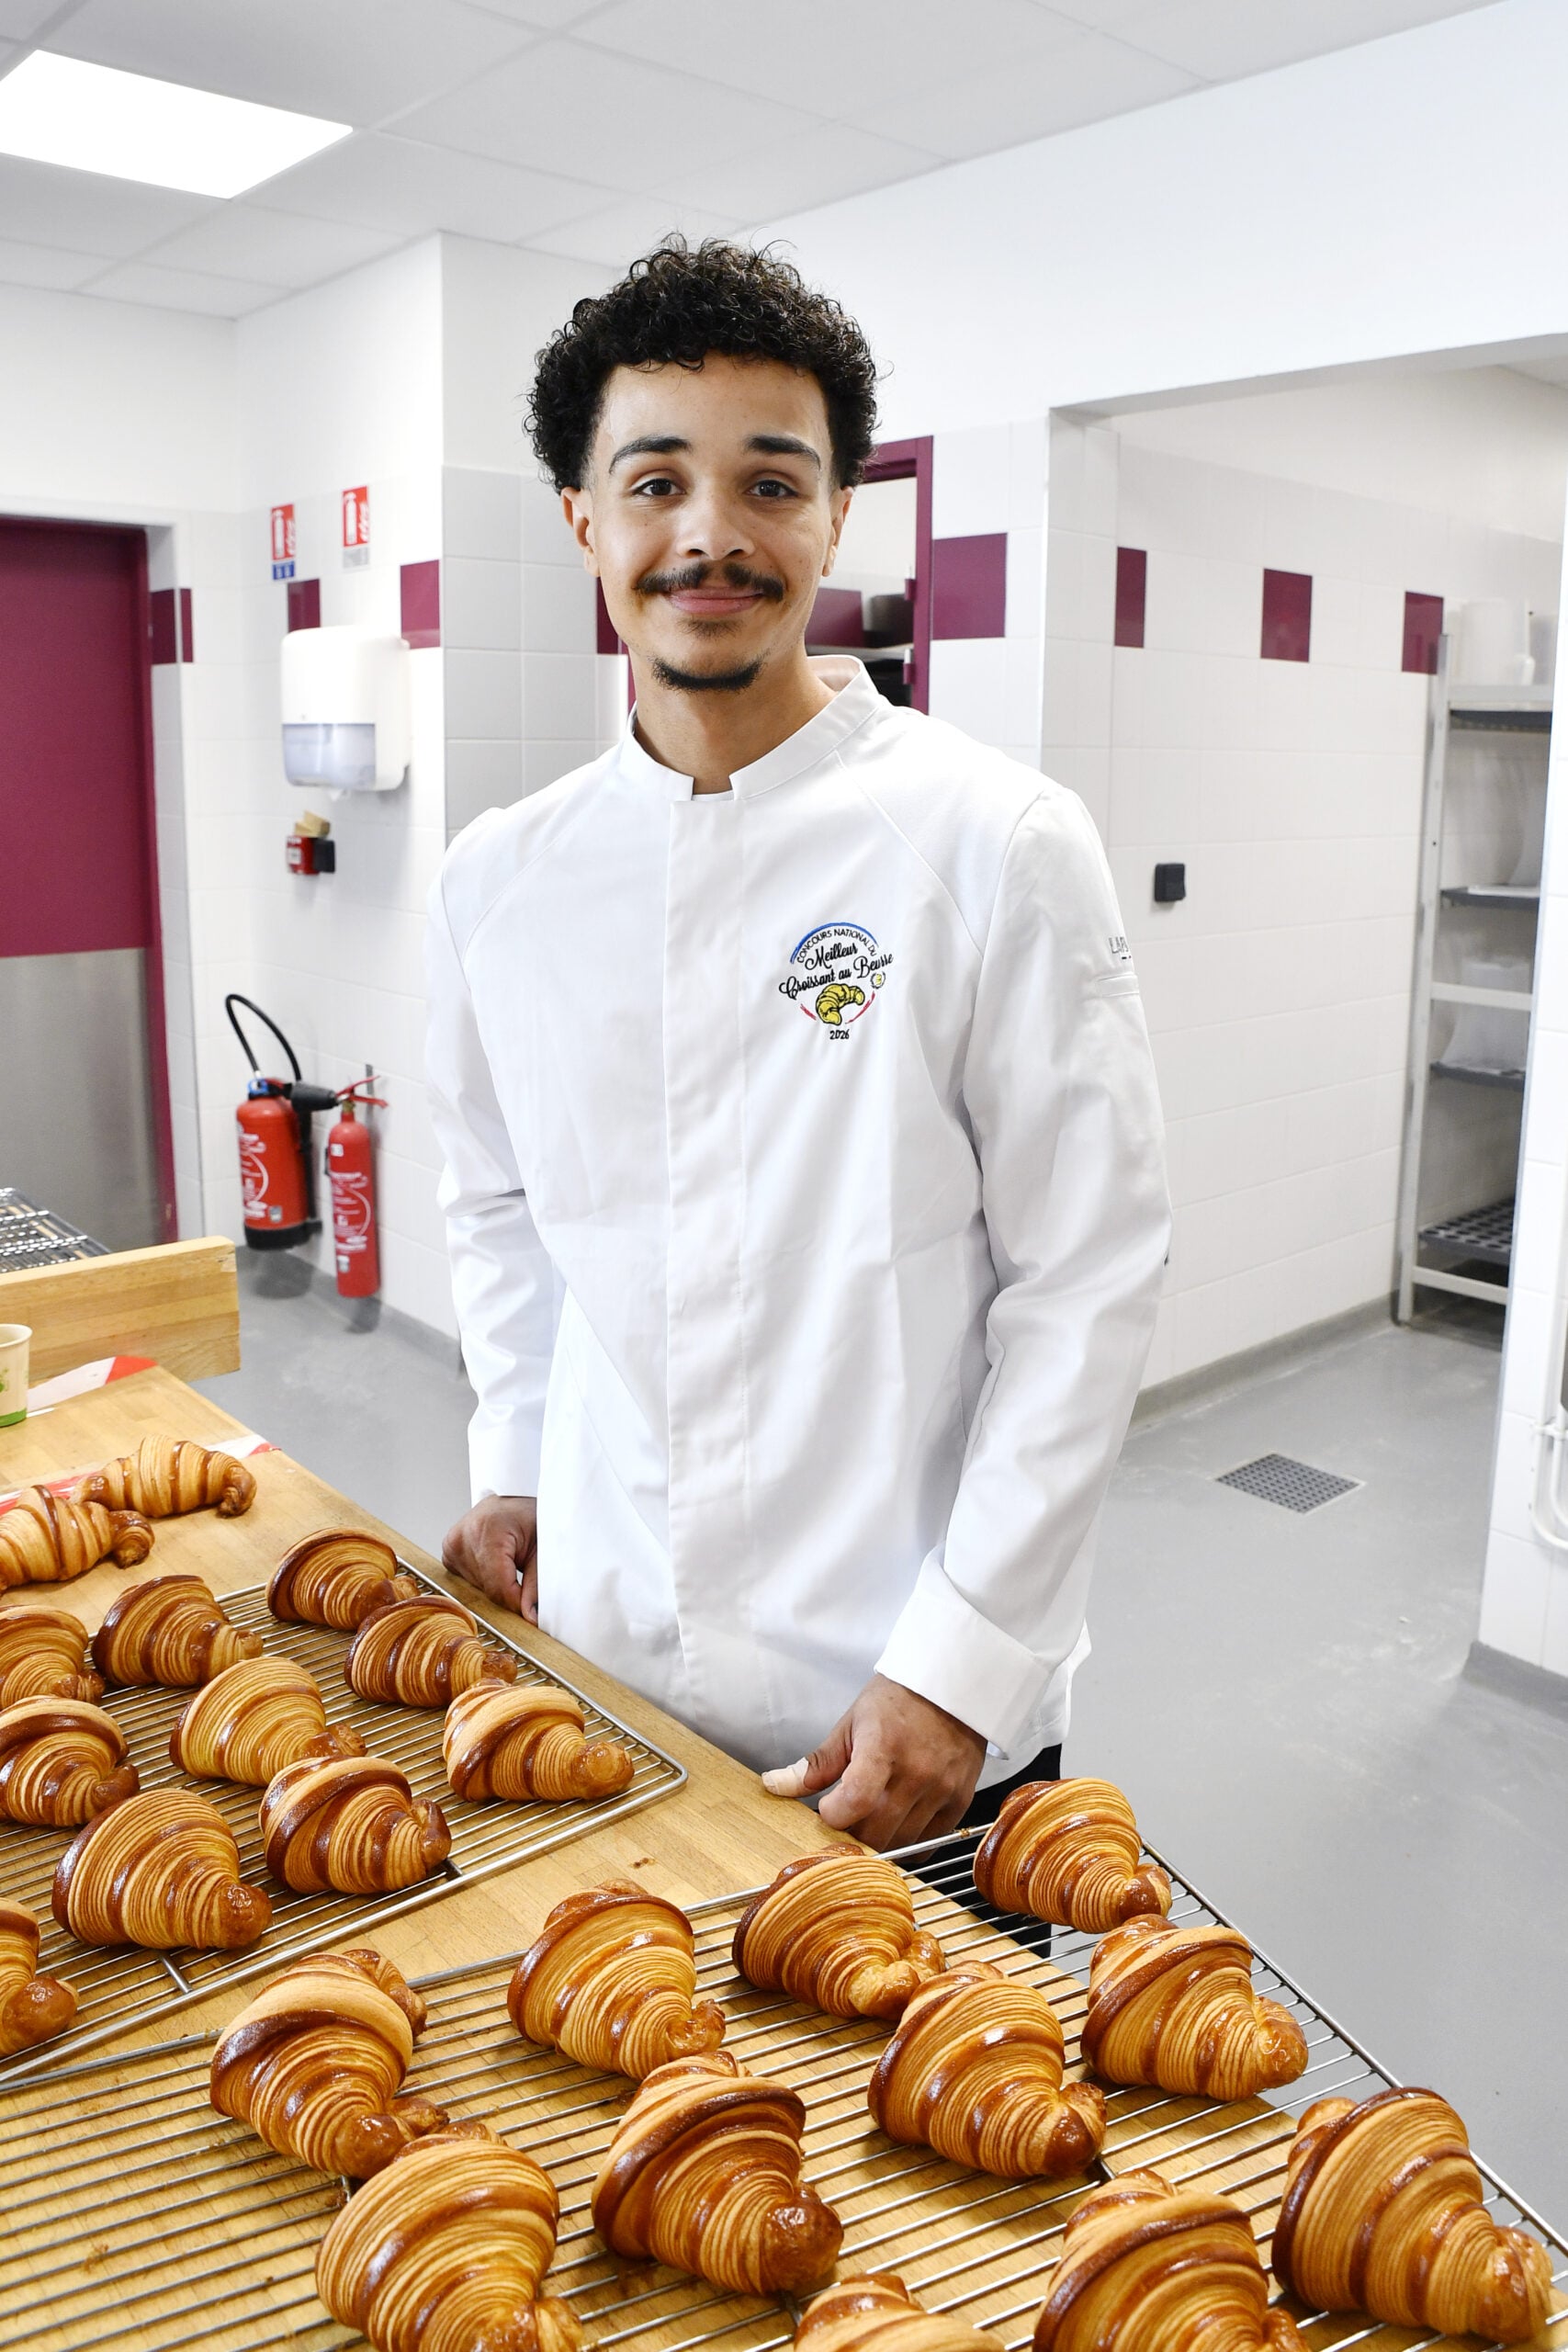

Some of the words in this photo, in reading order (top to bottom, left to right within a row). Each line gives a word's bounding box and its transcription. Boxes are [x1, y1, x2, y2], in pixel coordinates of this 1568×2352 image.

[796, 930, 832, 963] CONCOURS
[834, 928, 869, 946] NATIONAL
[868, 944, 877, 956] DU
[805, 943, 858, 970] Meilleur
[778, 969, 836, 1001] Croissant
[839, 968, 852, 979] au
[853, 954, 894, 978] Beurre
[829, 1029, 850, 1040] 2026
